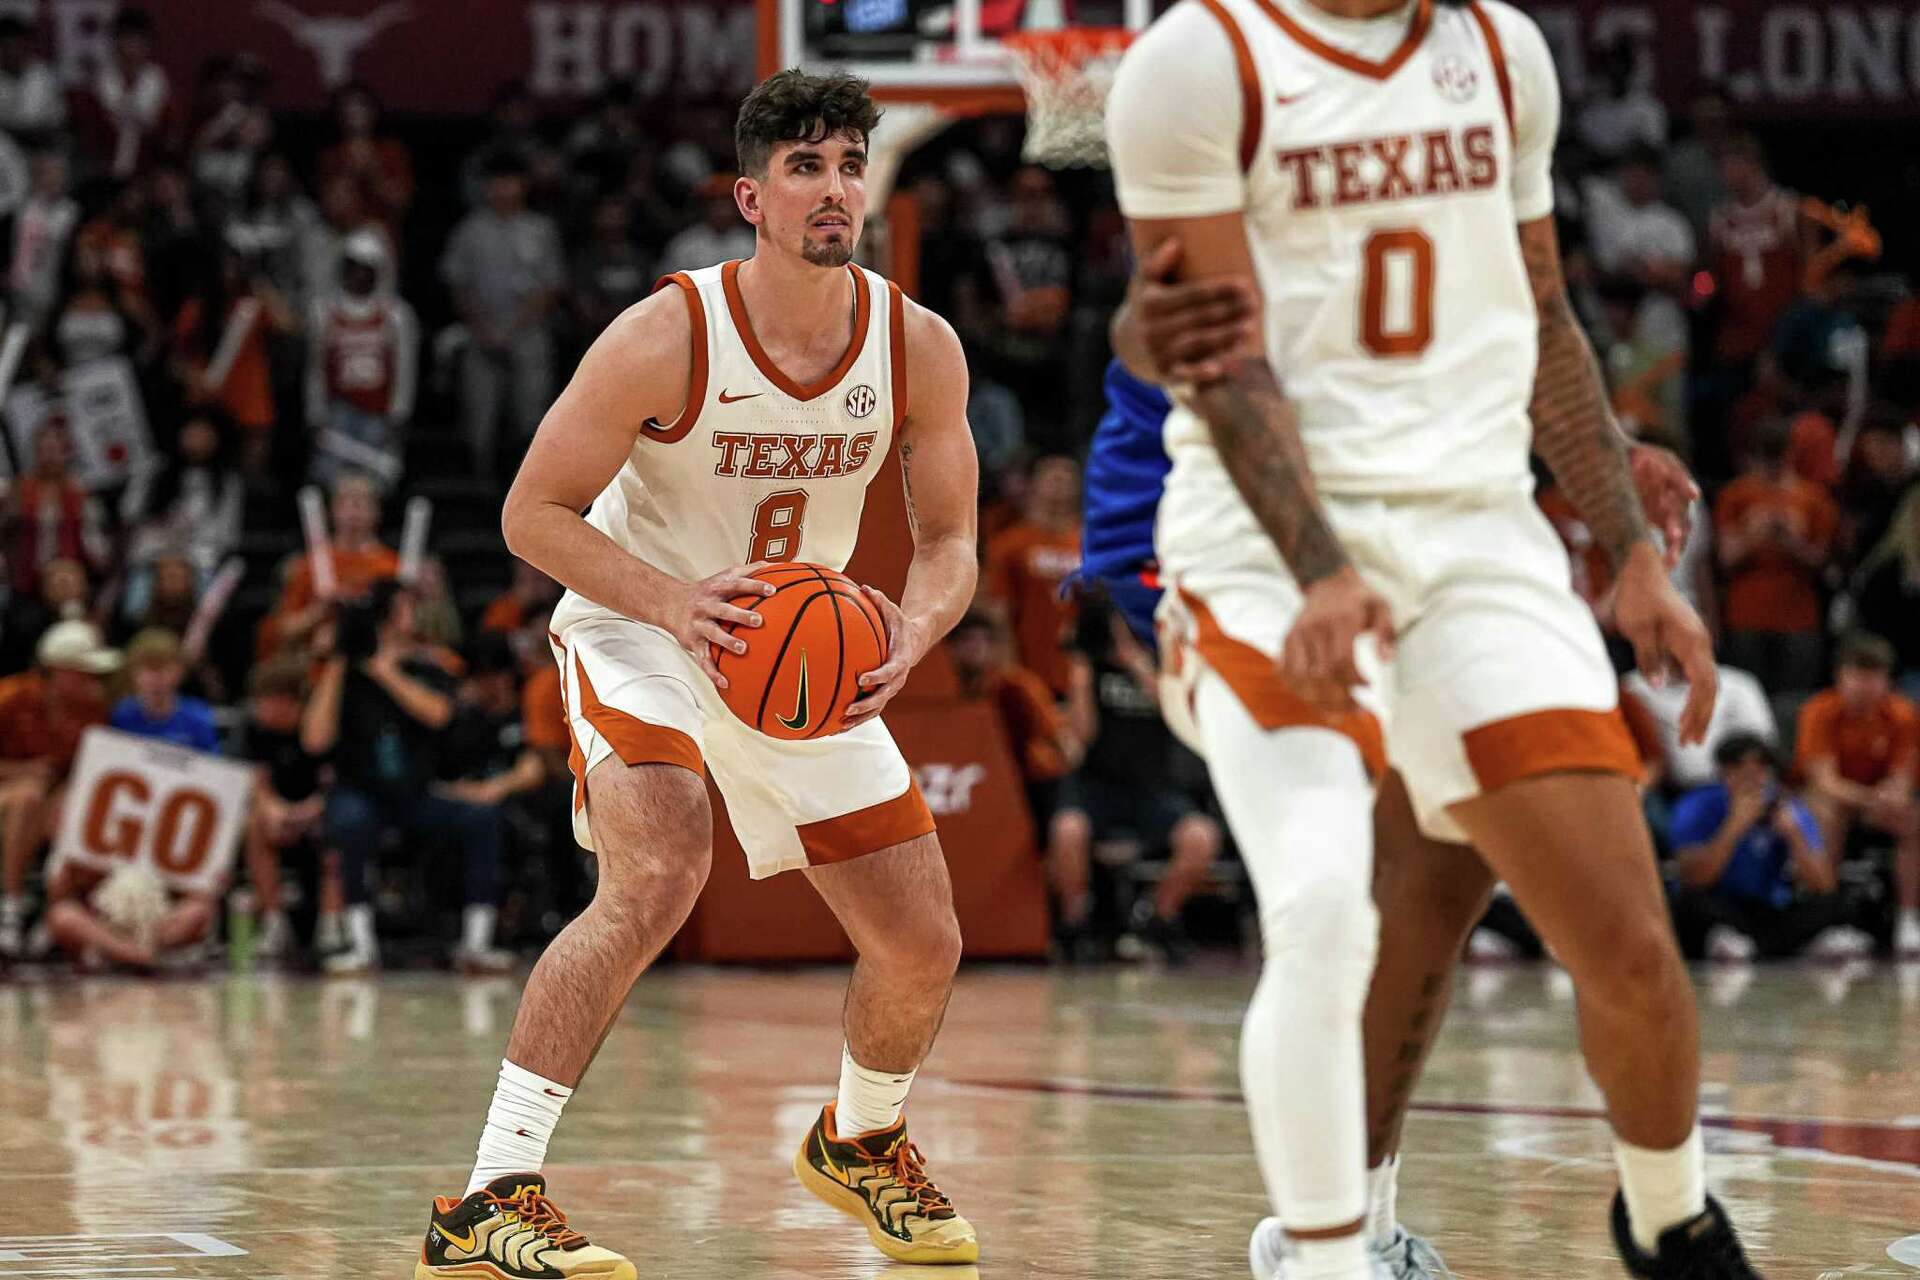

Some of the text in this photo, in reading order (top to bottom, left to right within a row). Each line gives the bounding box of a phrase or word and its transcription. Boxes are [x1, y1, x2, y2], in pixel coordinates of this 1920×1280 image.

[1275, 124, 1498, 211] TEXAS
[1358, 225, 1436, 359] 0
[846, 384, 877, 418] SEC
[711, 431, 878, 479] TEXAS
[745, 488, 810, 565] 8
[83, 768, 219, 876] GO
